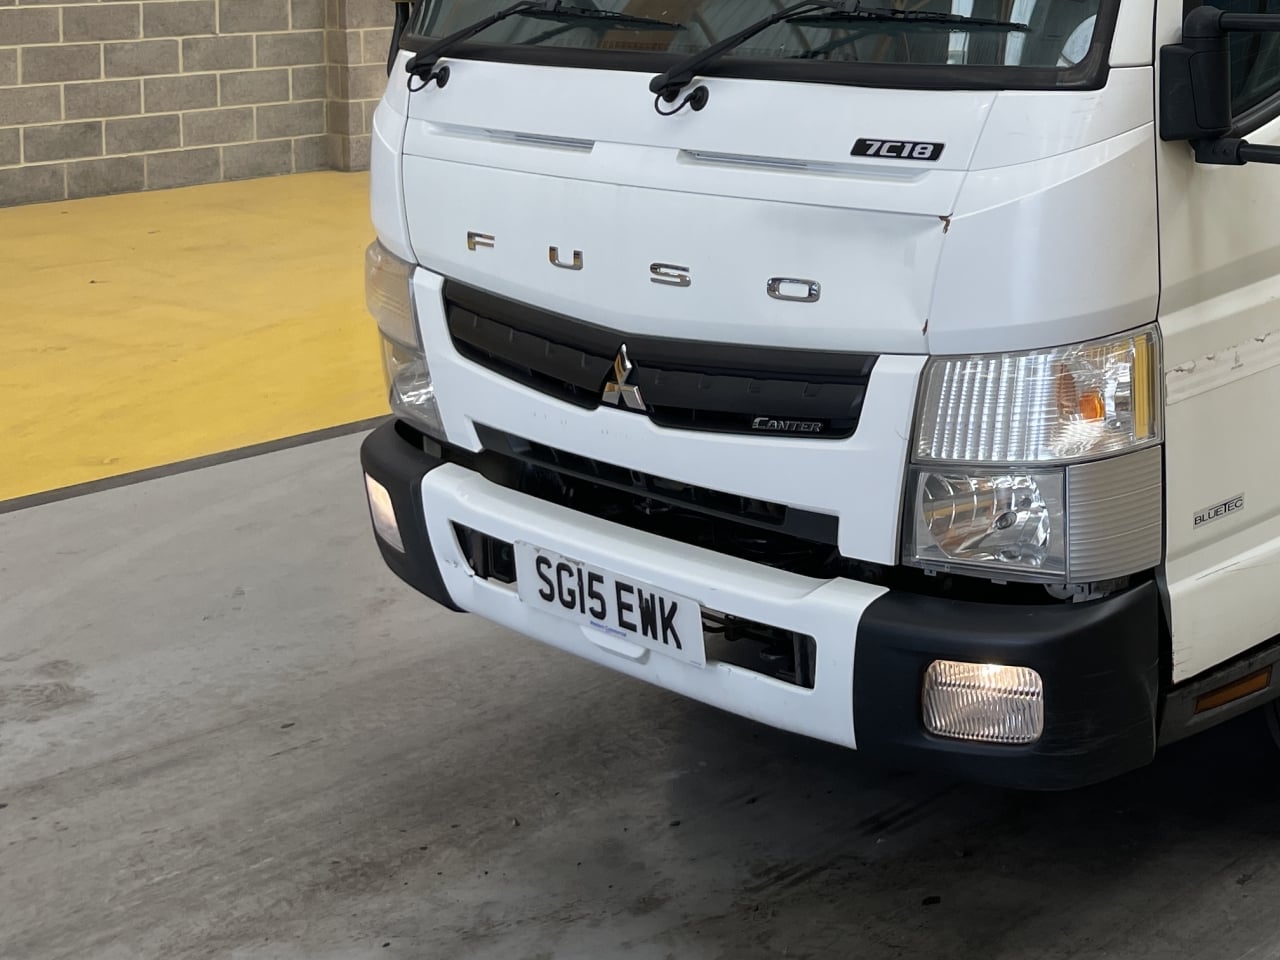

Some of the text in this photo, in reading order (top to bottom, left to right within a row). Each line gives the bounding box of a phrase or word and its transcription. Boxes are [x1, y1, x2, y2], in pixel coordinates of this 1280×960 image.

[865, 140, 935, 158] 7C18
[467, 230, 821, 302] FUSO
[1194, 495, 1243, 526] BLUETEC
[535, 554, 683, 650] SG15 EWK
